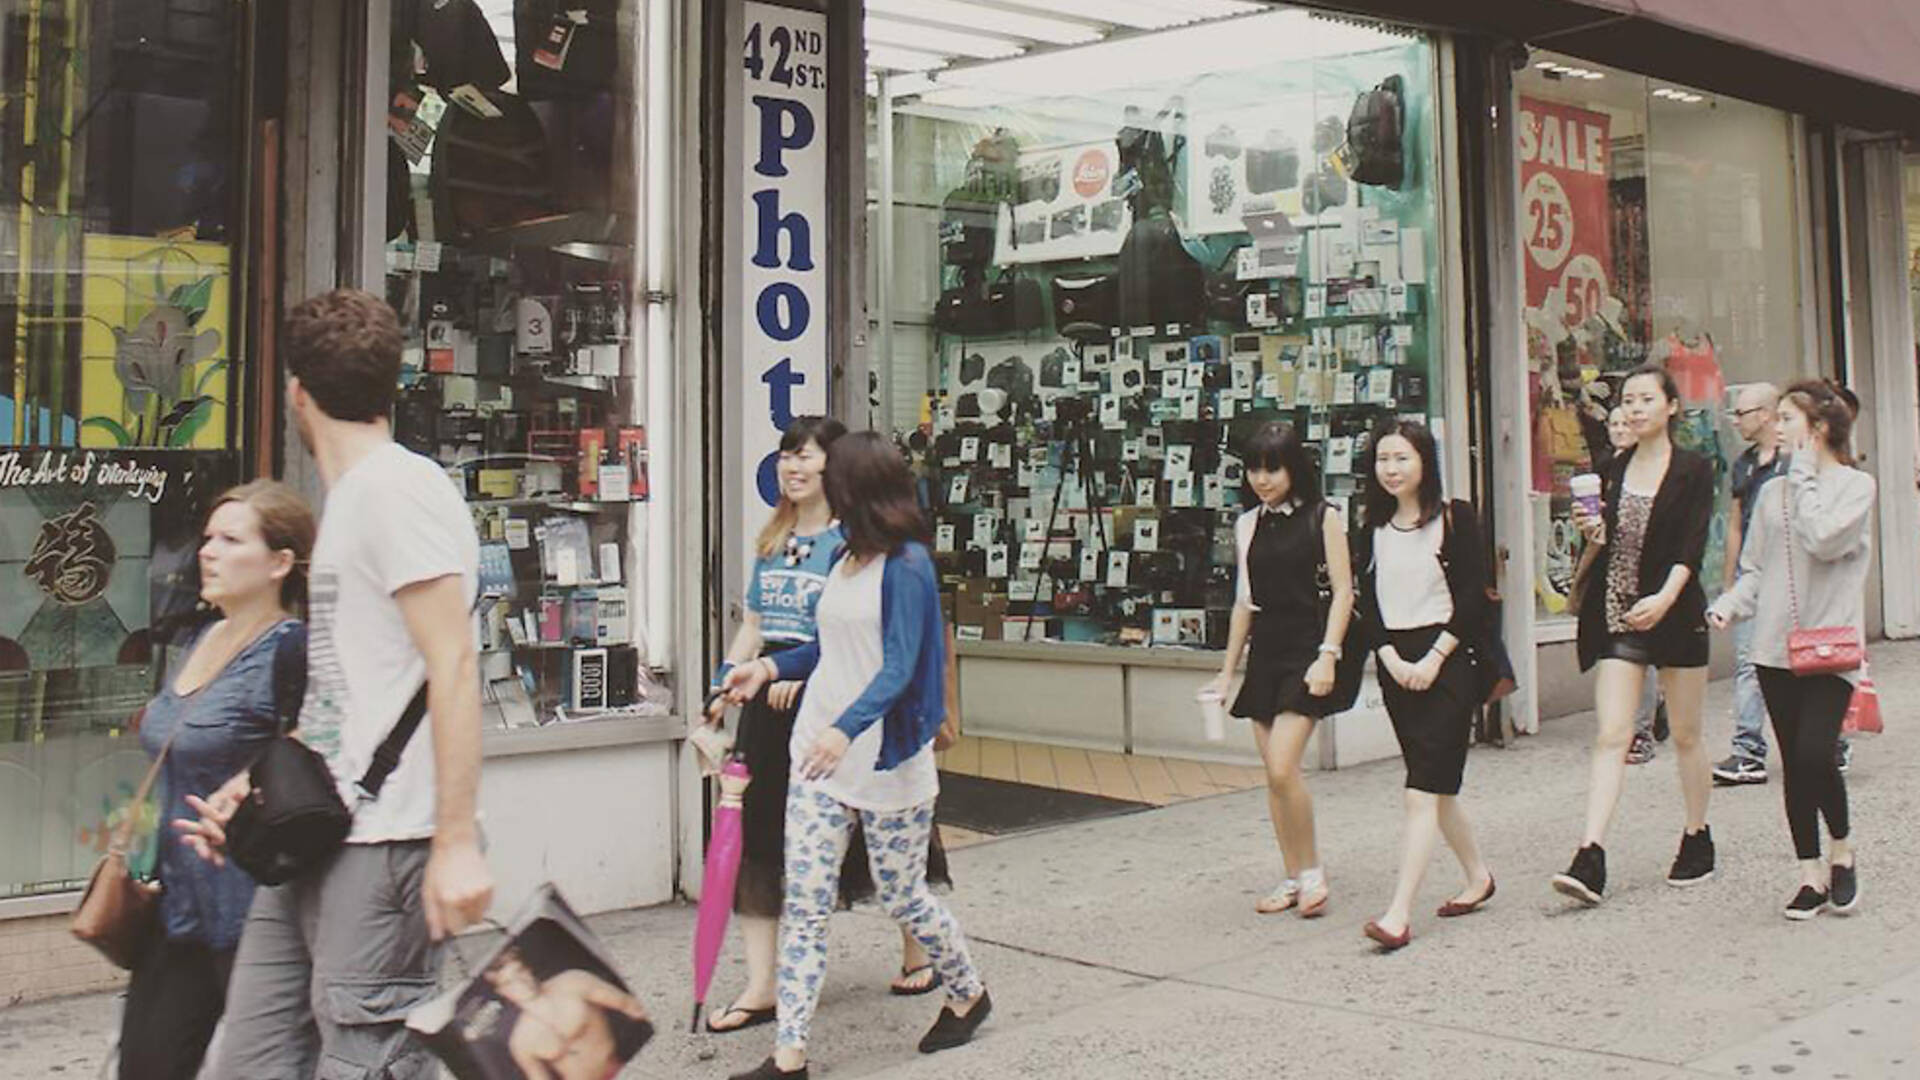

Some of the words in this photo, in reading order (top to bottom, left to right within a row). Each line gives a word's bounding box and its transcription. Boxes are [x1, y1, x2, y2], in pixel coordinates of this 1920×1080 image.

[796, 63, 825, 88] ST.
[1519, 111, 1604, 175] SALE
[1529, 198, 1563, 250] 25
[1565, 276, 1600, 327] 50
[528, 318, 543, 336] 3
[0, 451, 31, 486] The
[30, 450, 67, 485] Art
[70, 450, 95, 485] of
